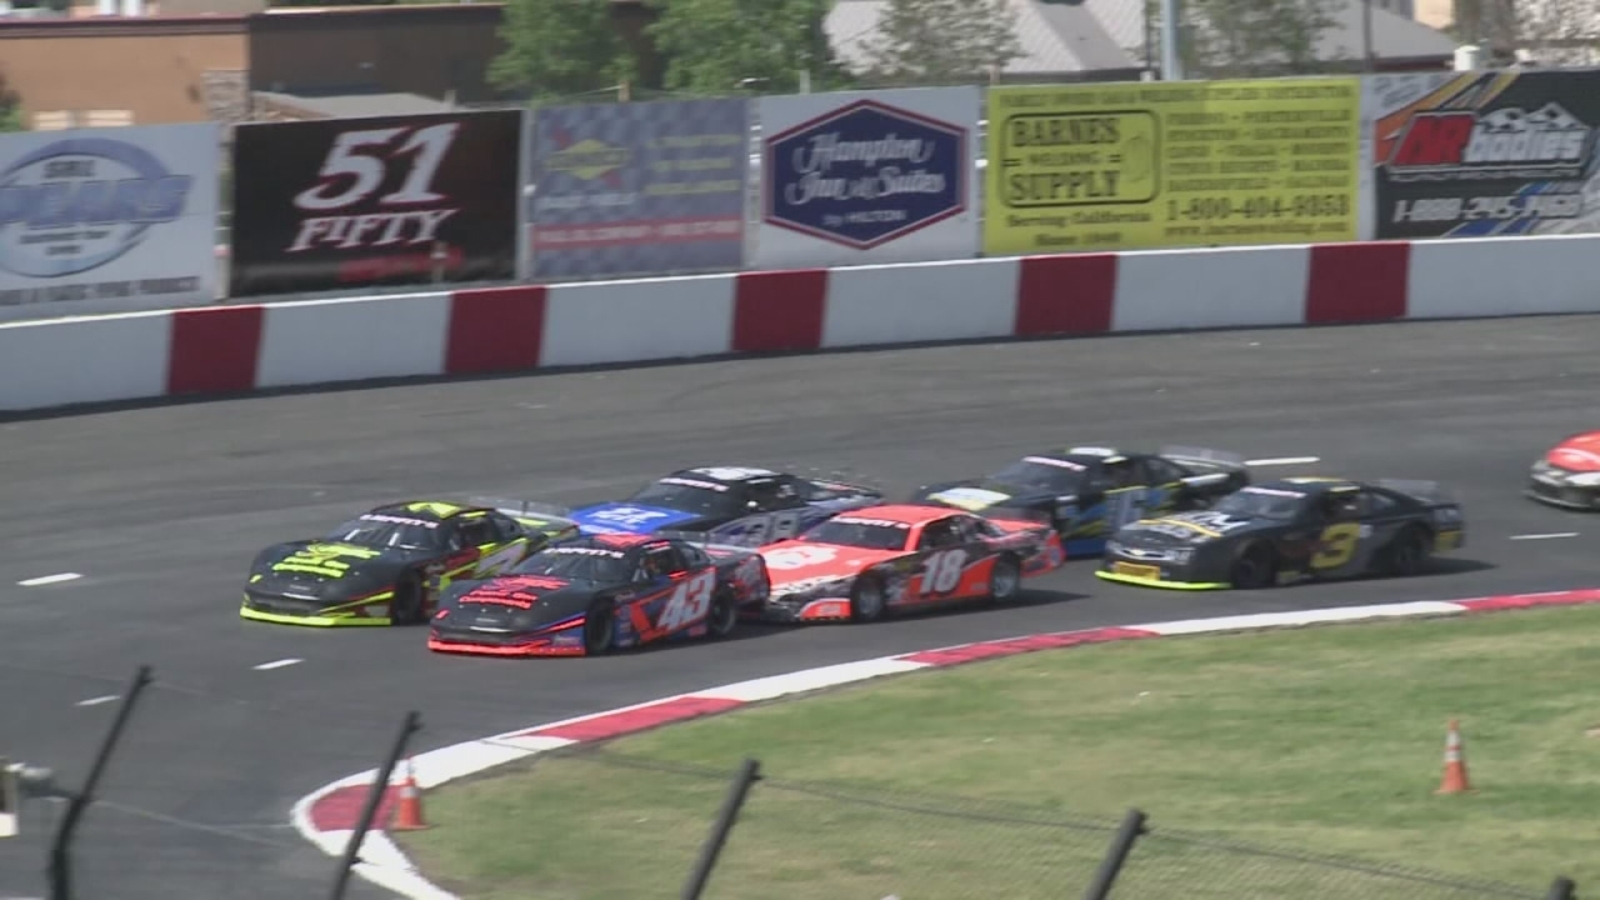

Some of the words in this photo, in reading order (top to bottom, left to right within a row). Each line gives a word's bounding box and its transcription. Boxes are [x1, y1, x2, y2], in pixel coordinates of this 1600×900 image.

[792, 131, 936, 174] Hampton
[1012, 117, 1120, 147] BARNES
[292, 122, 462, 211] 51
[784, 171, 852, 206] Inn
[877, 165, 946, 198] Suites
[1010, 170, 1121, 200] SUPPLY
[283, 208, 462, 253] FIFTY
[1070, 211, 1151, 225] California
[1310, 522, 1362, 570] 3
[920, 549, 968, 595] 18
[658, 570, 717, 631] 43
